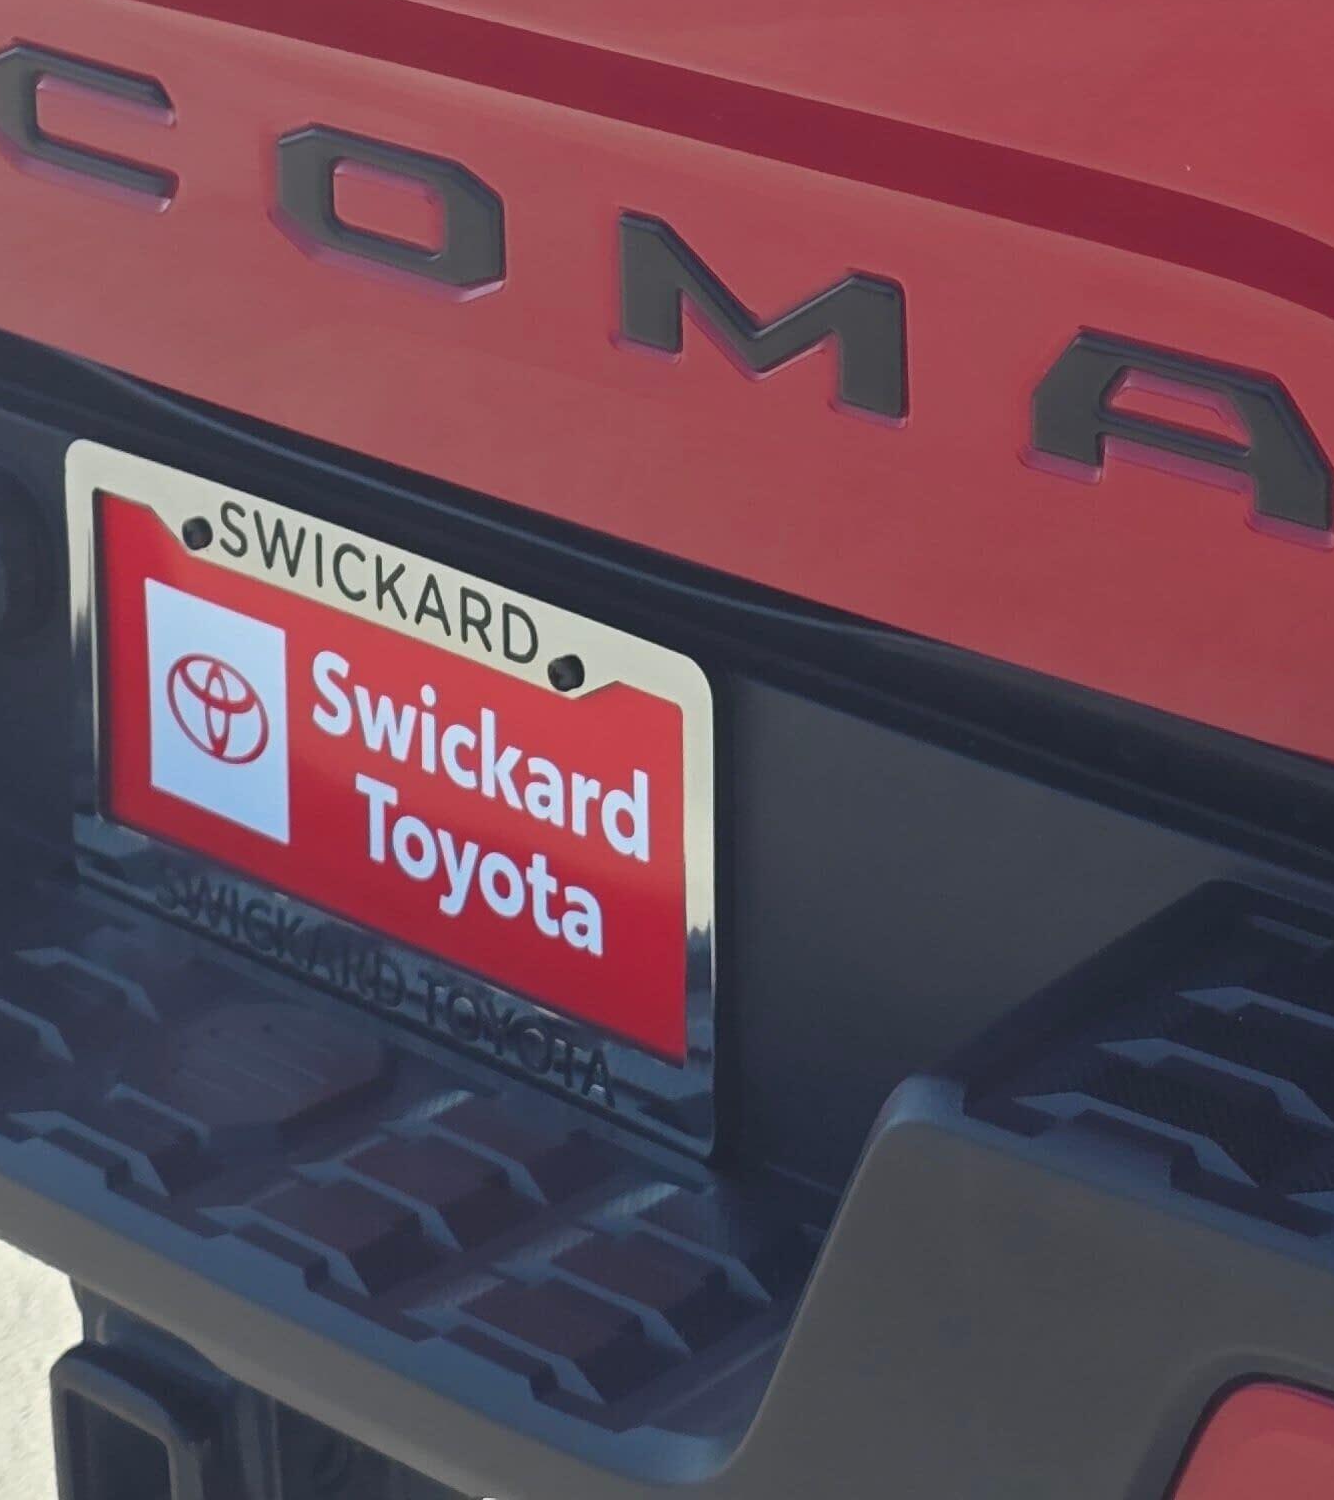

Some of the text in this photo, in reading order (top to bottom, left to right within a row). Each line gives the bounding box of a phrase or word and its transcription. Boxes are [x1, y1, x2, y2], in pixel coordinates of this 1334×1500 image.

[219, 501, 540, 665] SWICKARD
[311, 650, 651, 864] Swickard
[354, 772, 604, 957] Toyota
[419, 972, 616, 1107] TOYOTA
